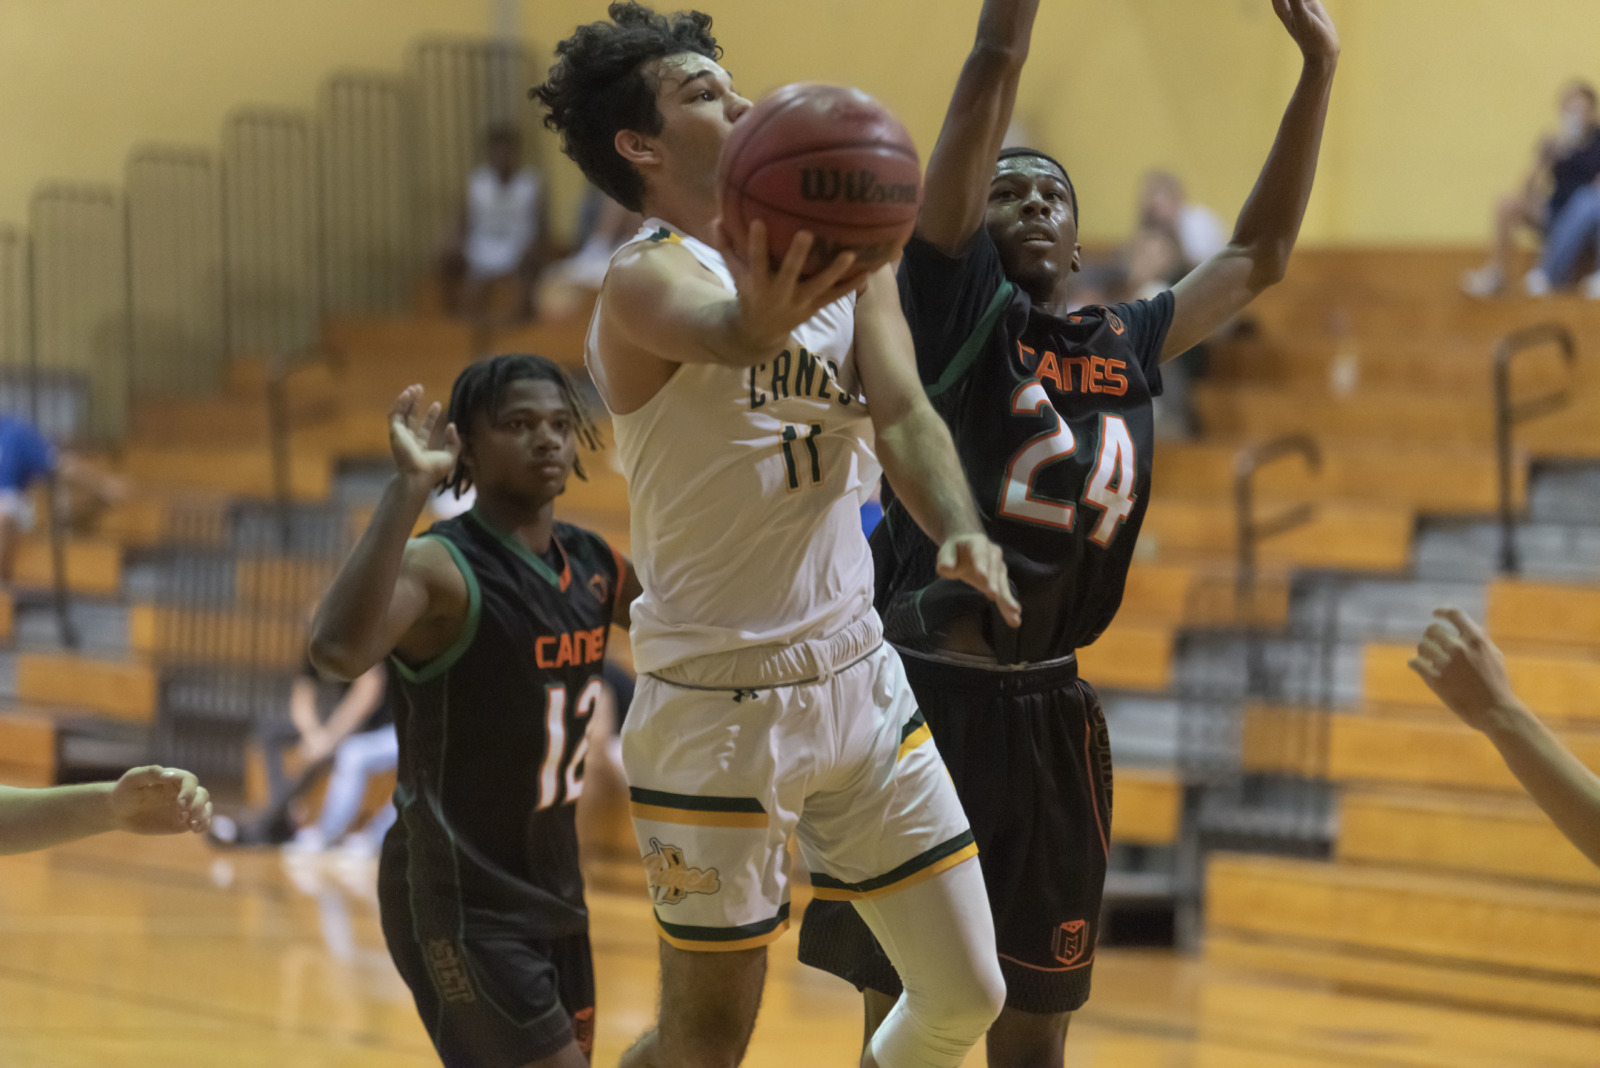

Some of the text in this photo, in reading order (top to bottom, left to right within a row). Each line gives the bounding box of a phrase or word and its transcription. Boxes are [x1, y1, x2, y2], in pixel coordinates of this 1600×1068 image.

[801, 168, 916, 203] Wilson
[780, 422, 823, 491] 11
[997, 377, 1138, 548] 24
[534, 625, 606, 670] CANE
[536, 676, 603, 811] 12
